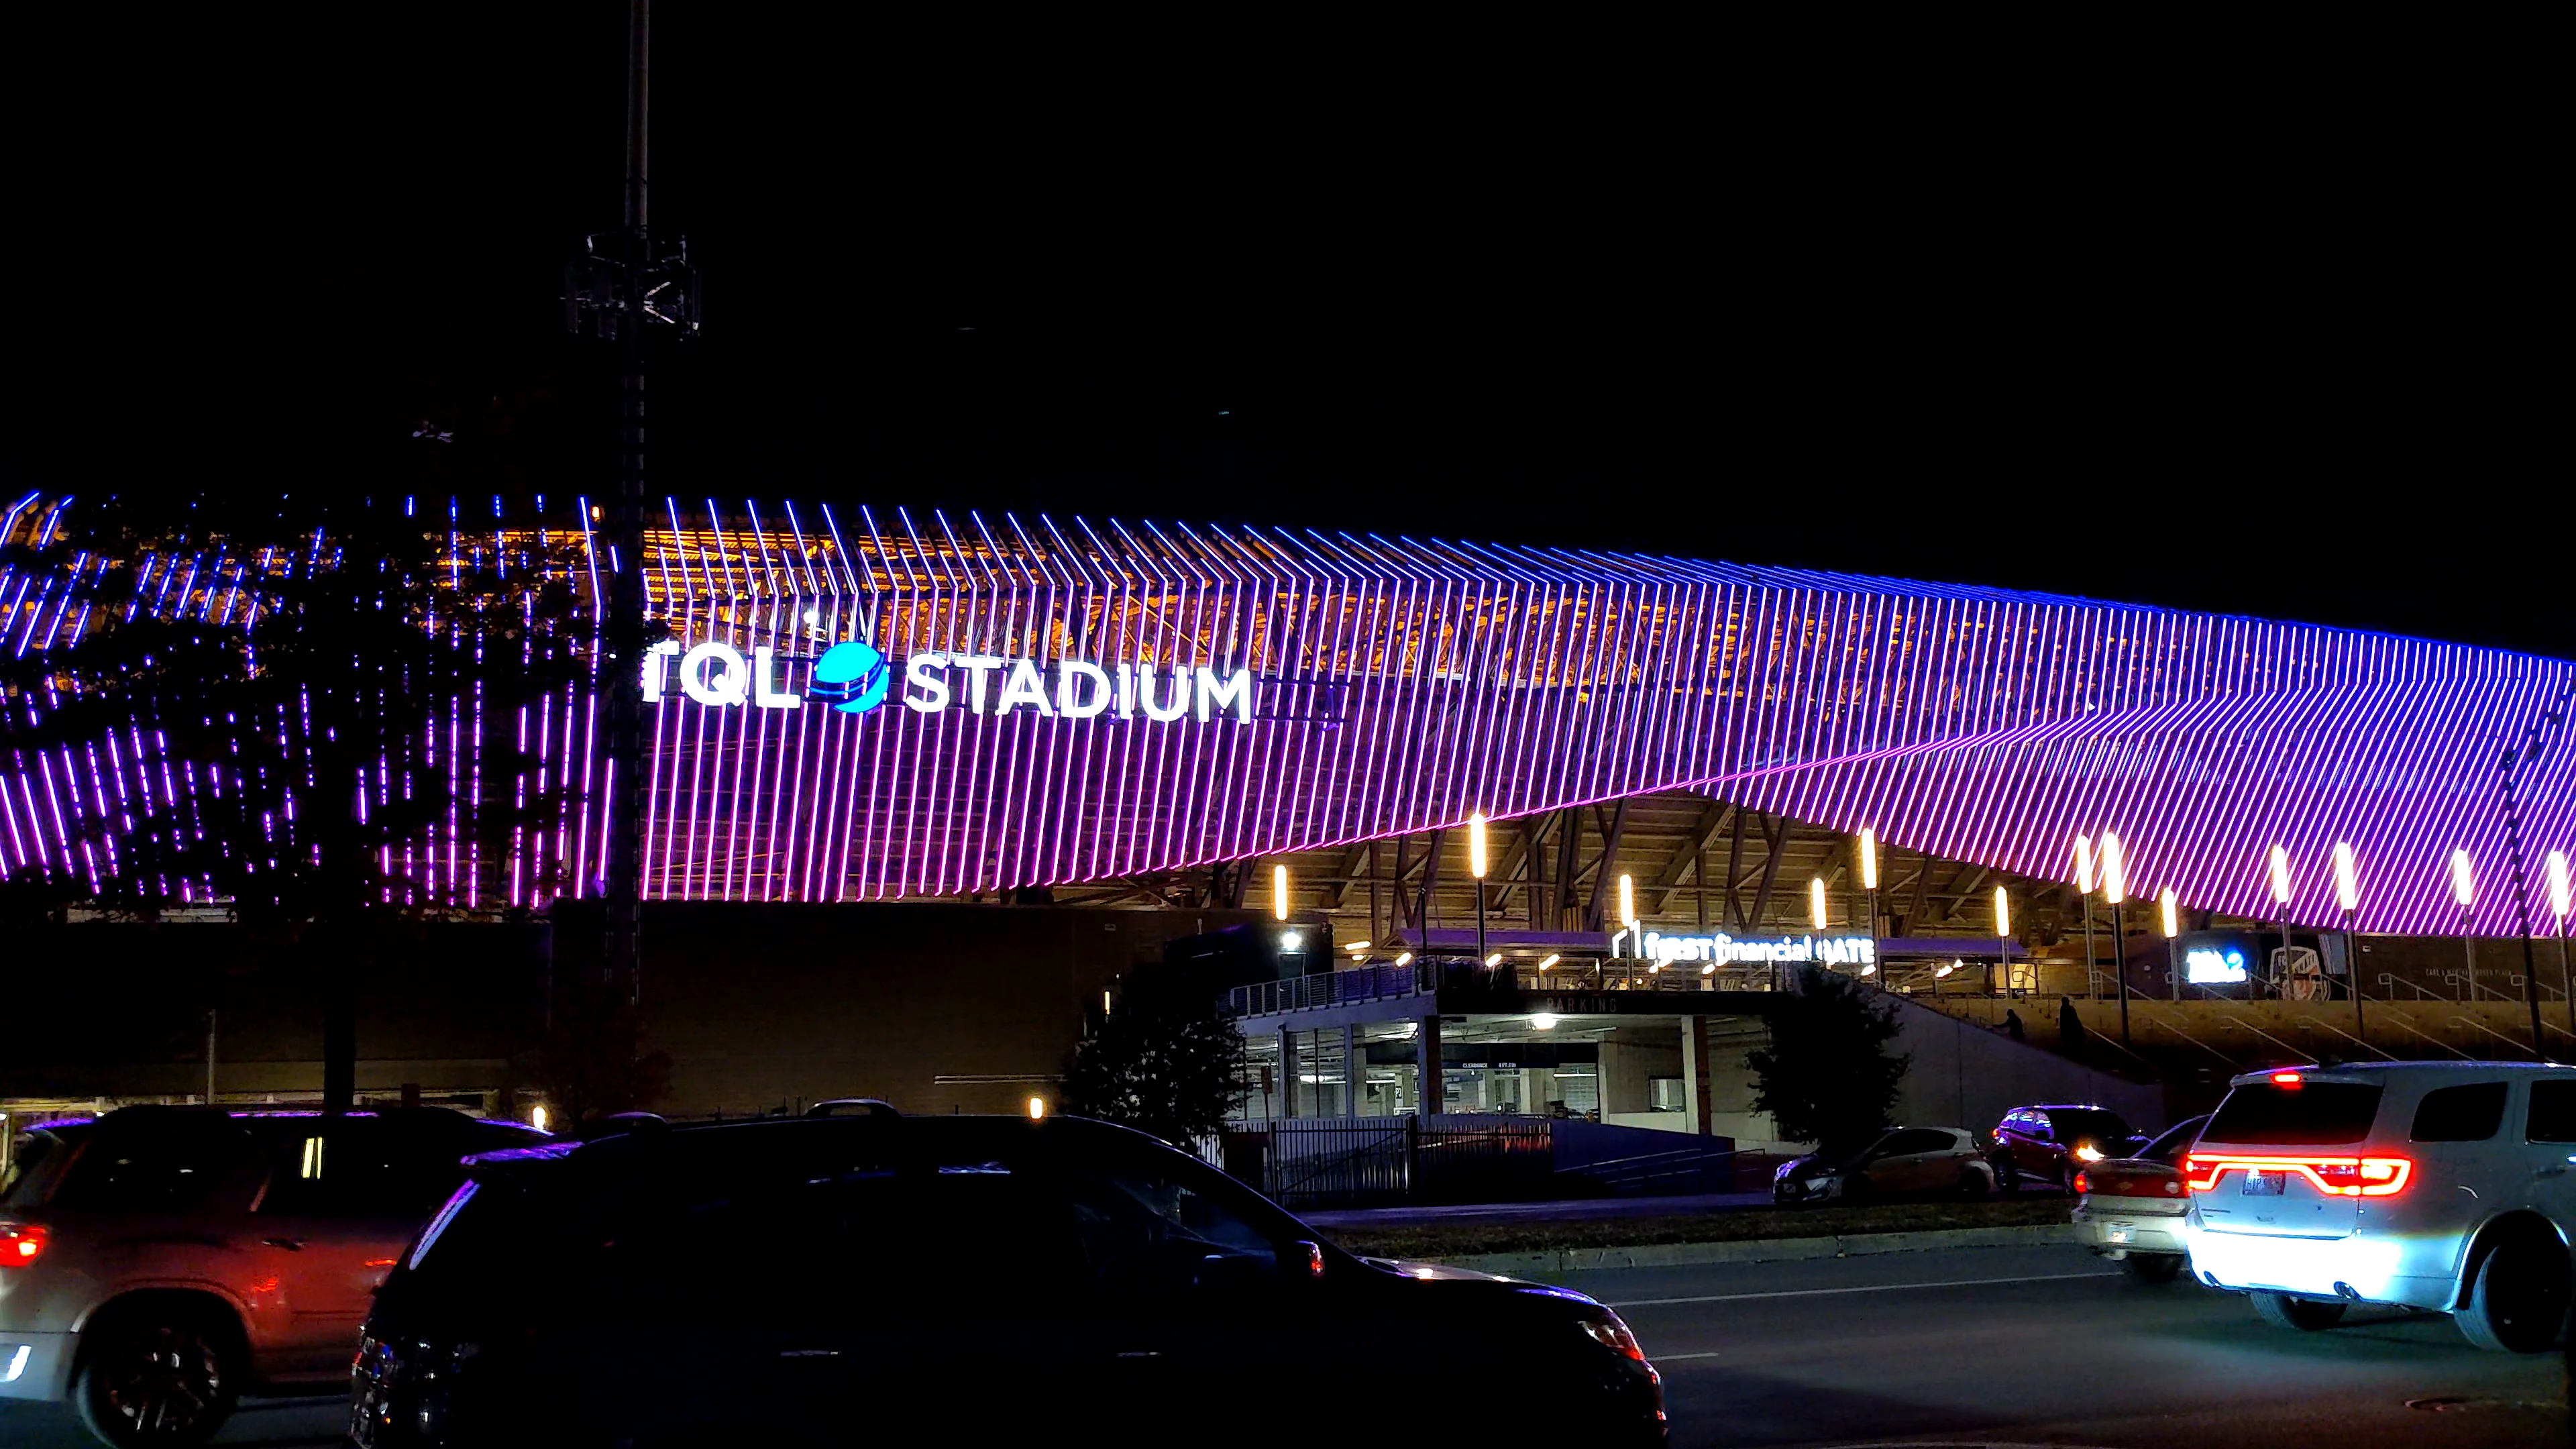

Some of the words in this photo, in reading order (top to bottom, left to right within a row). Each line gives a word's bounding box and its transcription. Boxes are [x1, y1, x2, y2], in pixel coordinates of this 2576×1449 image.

[641, 641, 802, 708] TQL
[905, 653, 1252, 724] STADIUM
[1713, 932, 1812, 961] financial
[1546, 997, 1617, 1014] PARKING
